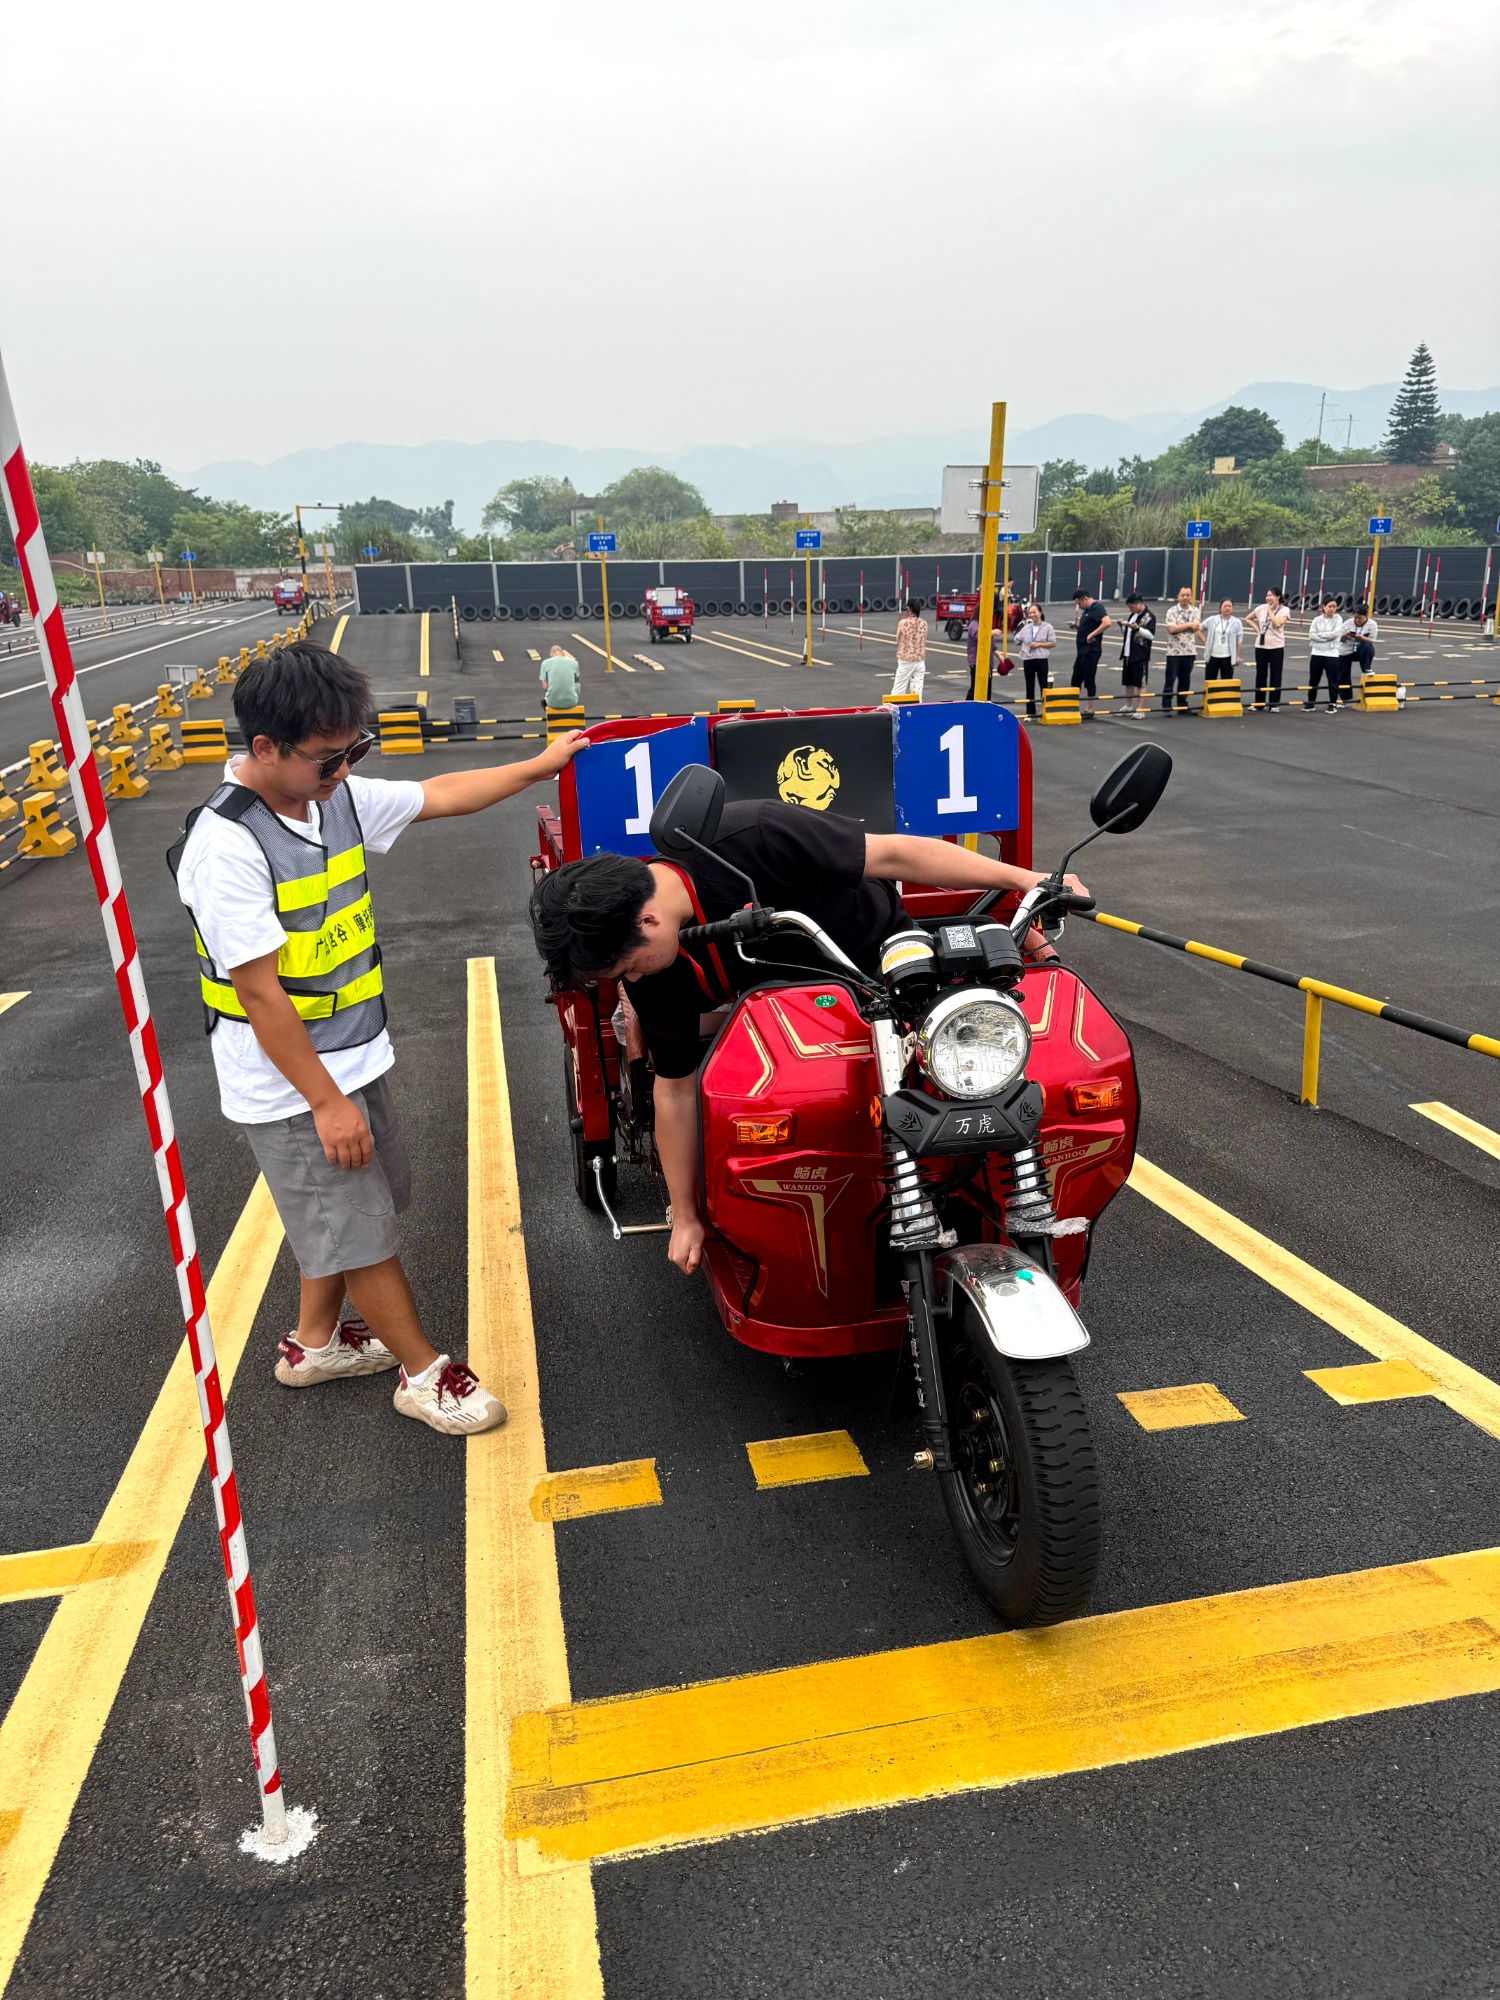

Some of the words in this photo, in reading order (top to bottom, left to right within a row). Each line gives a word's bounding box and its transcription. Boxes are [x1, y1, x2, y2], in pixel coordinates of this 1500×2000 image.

[624, 742, 654, 835] 1
[937, 724, 978, 815] 1
[955, 1113, 996, 1135] 万虎
[1043, 1149, 1086, 1165] WANHOO
